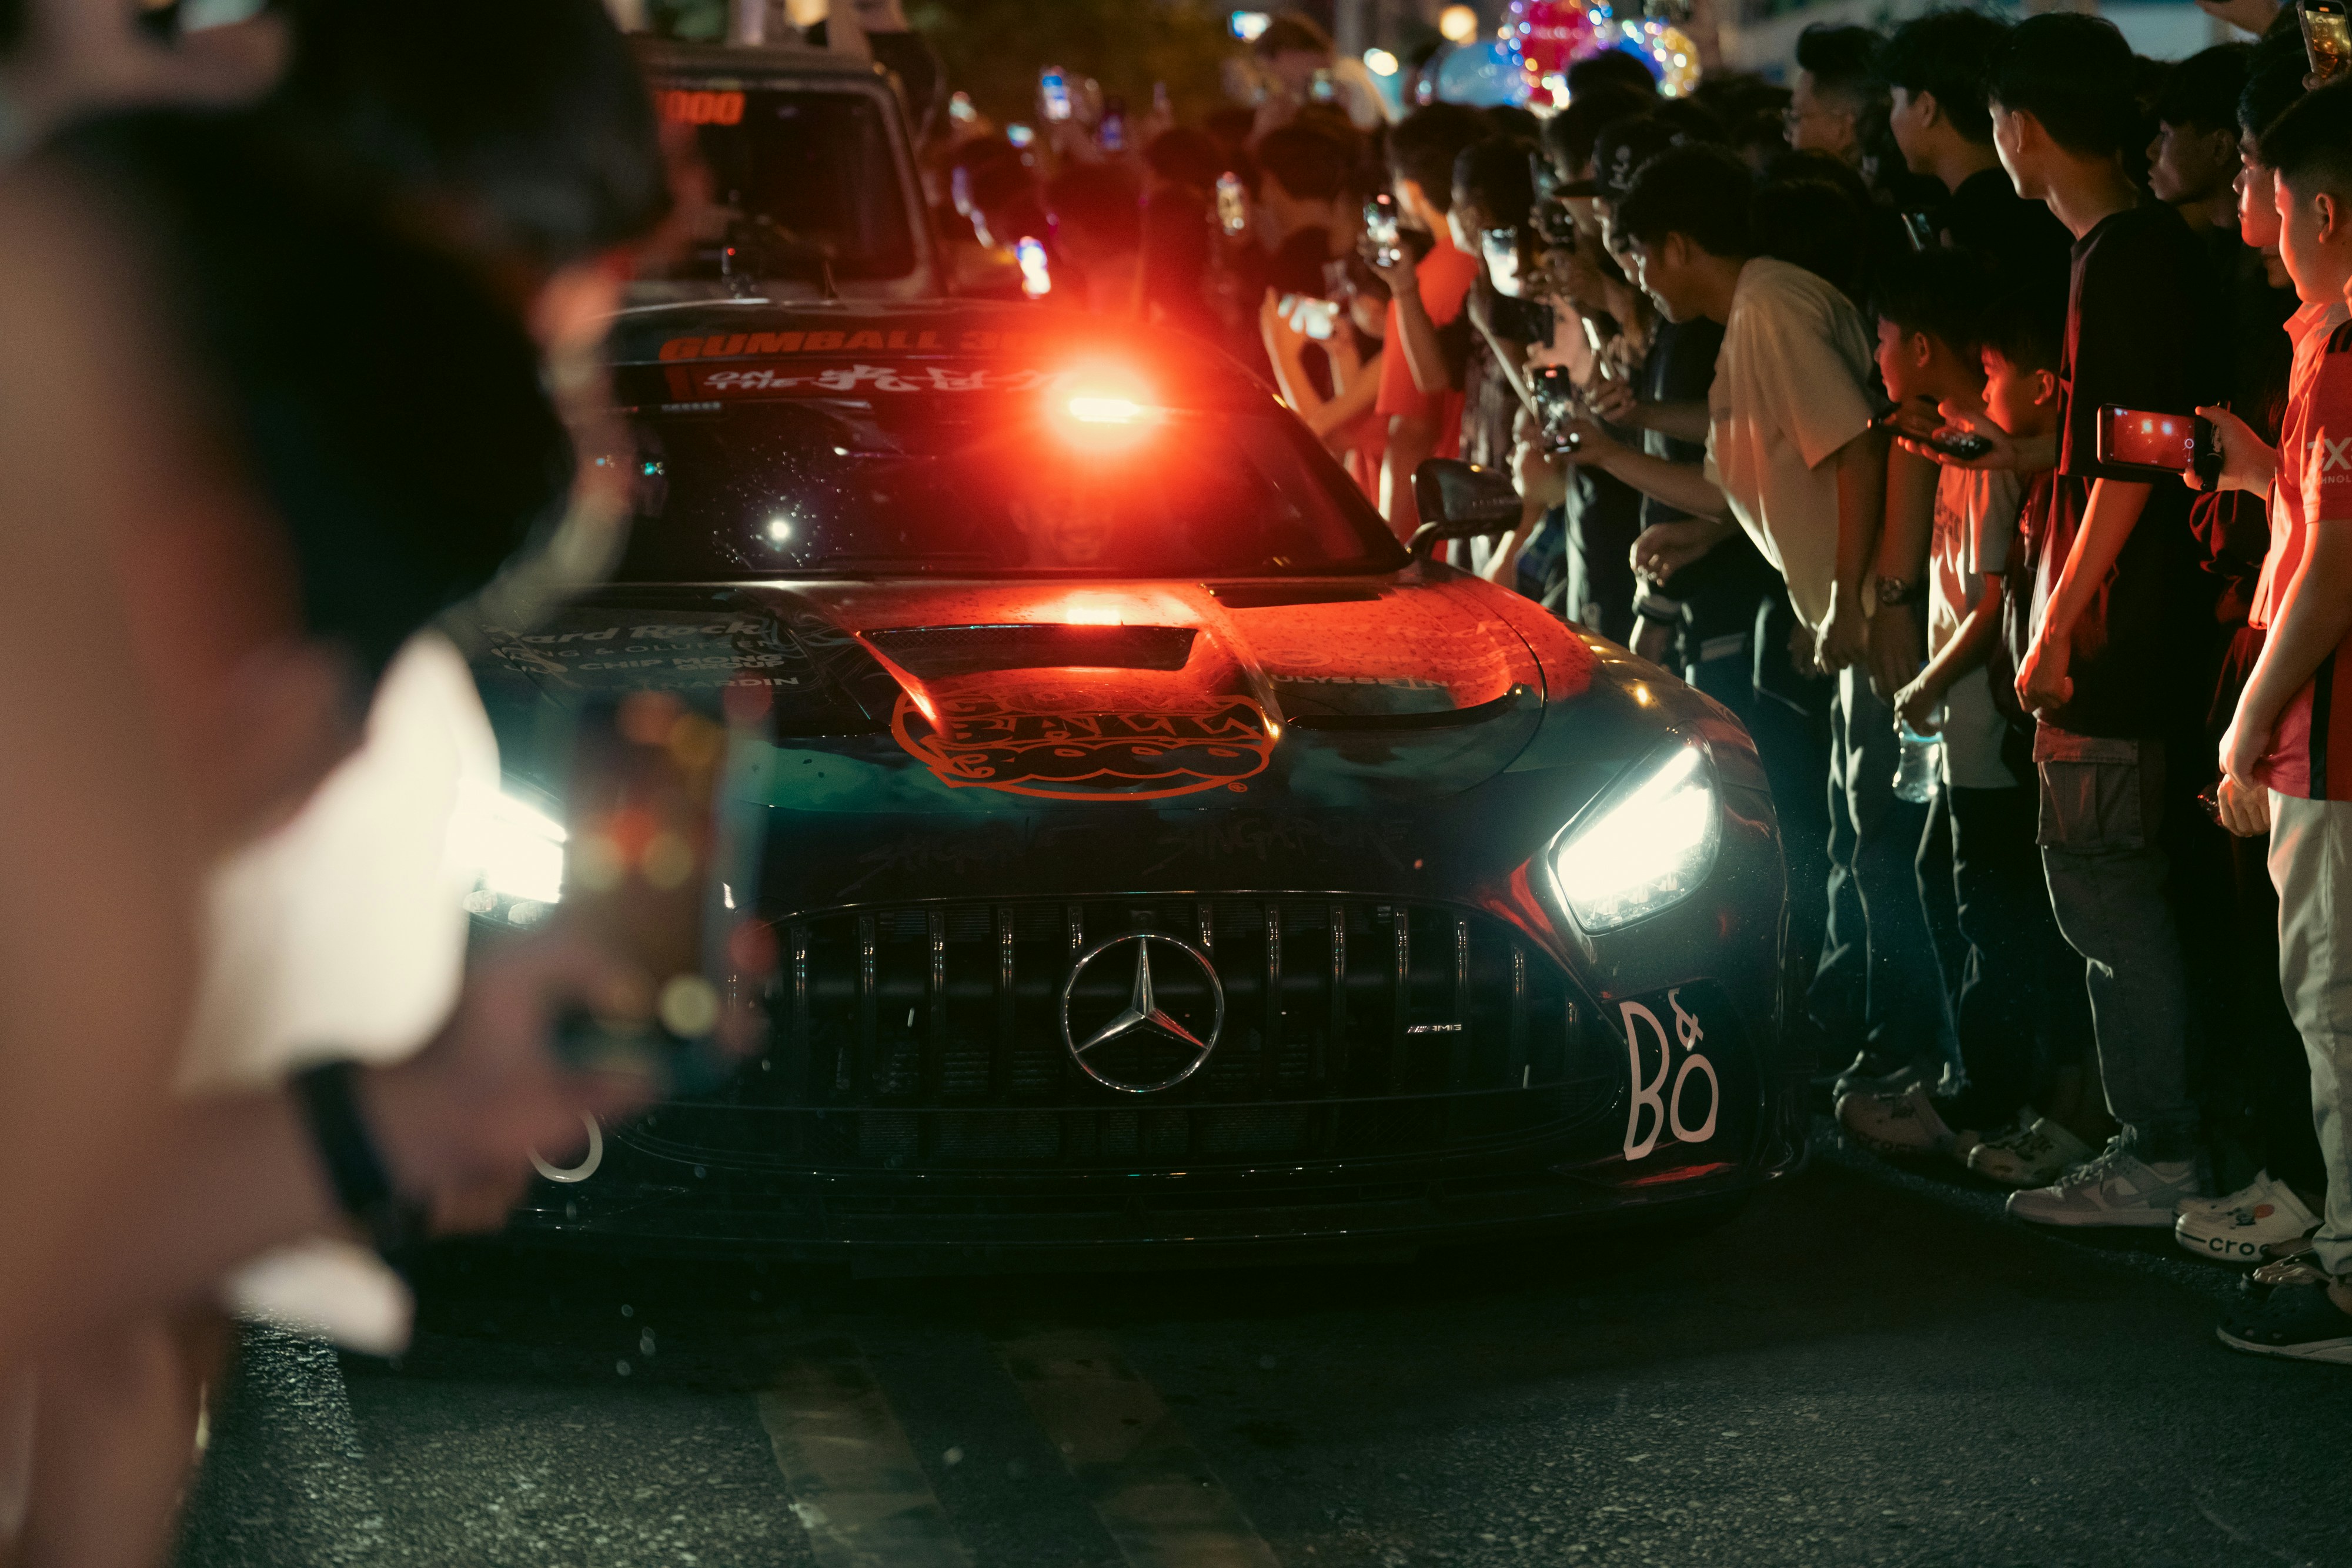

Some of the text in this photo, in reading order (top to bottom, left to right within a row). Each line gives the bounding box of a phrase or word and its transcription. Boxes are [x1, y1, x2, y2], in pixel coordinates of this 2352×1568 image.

[659, 330, 944, 360] GUMBALL
[629, 621, 770, 639] Rock
[579, 654, 782, 670] CHIP MONG
[677, 661, 784, 671] GROUP
[1271, 674, 1398, 685] ULYSSE
[2209, 1237, 2271, 1256] croc
